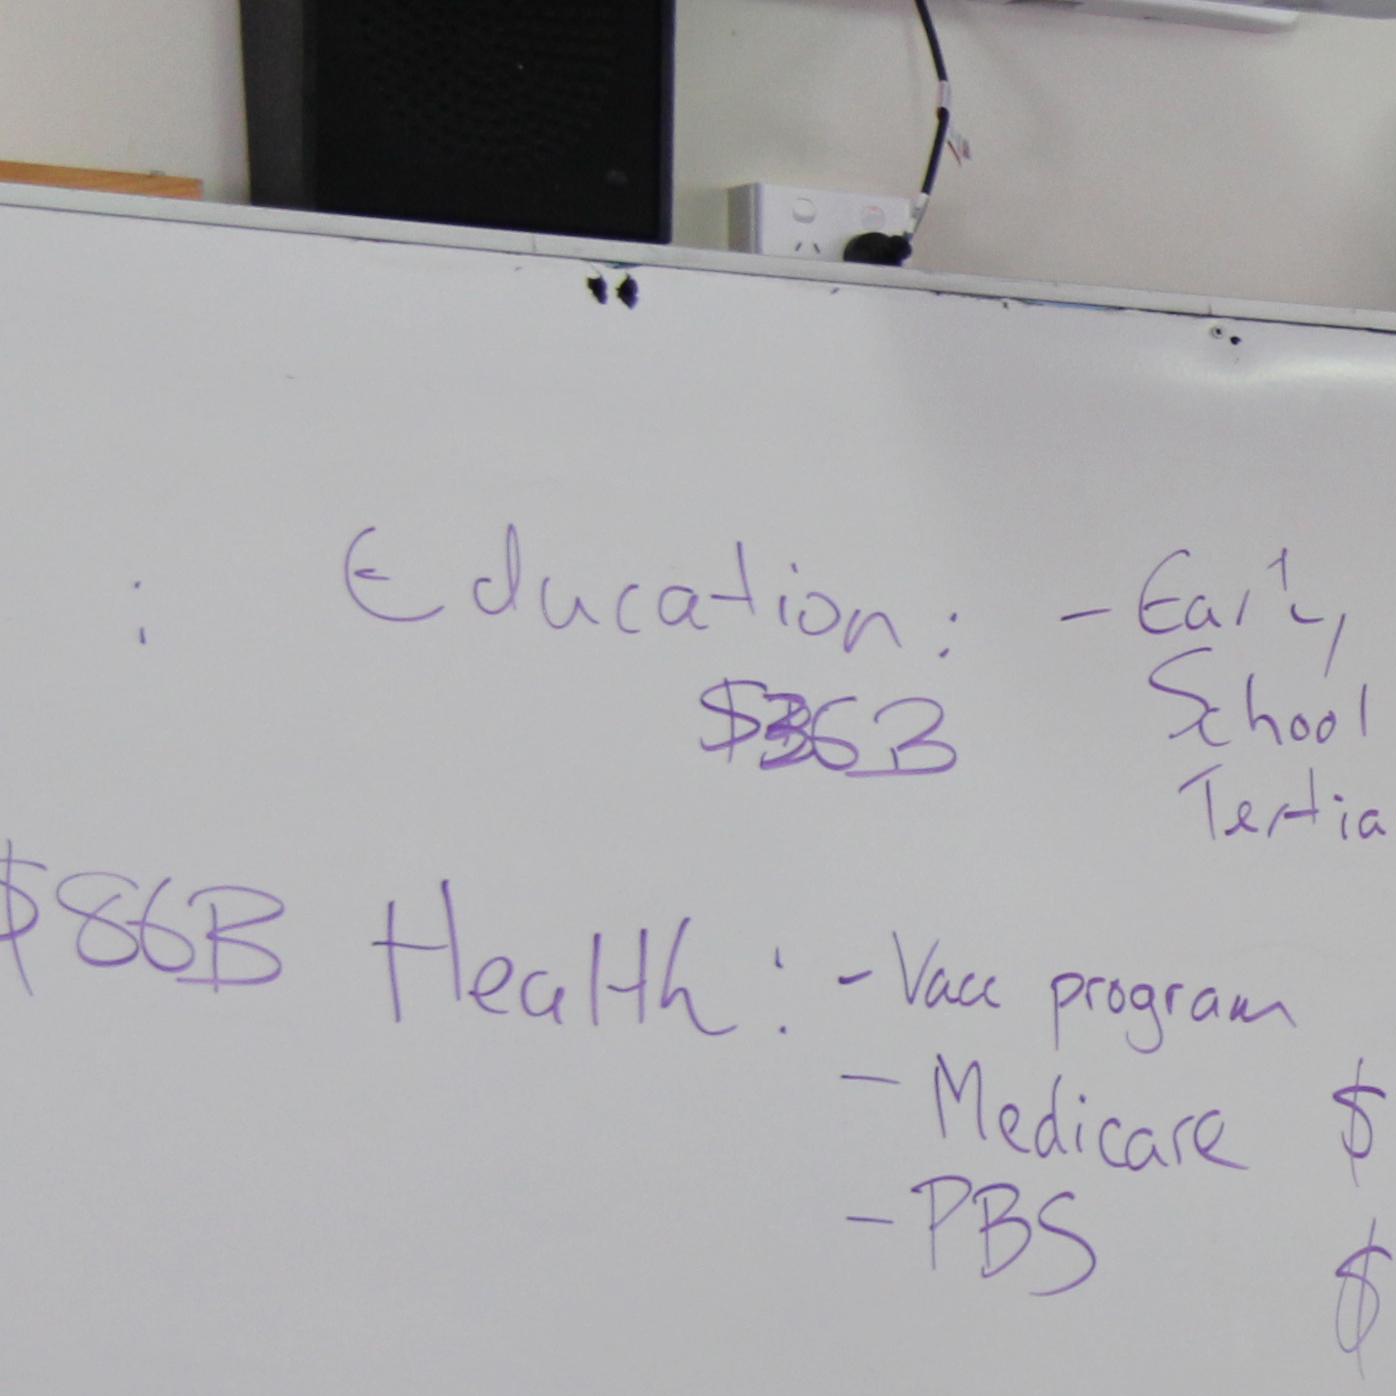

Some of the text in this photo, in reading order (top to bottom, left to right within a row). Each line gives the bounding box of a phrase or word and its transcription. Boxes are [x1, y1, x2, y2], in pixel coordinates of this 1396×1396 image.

[1147, 646, 1369, 750] School
[1050, 971, 1298, 1055] program
[932, 1053, 1250, 1171] Medicare
[910, 1173, 1099, 1297] PBS
